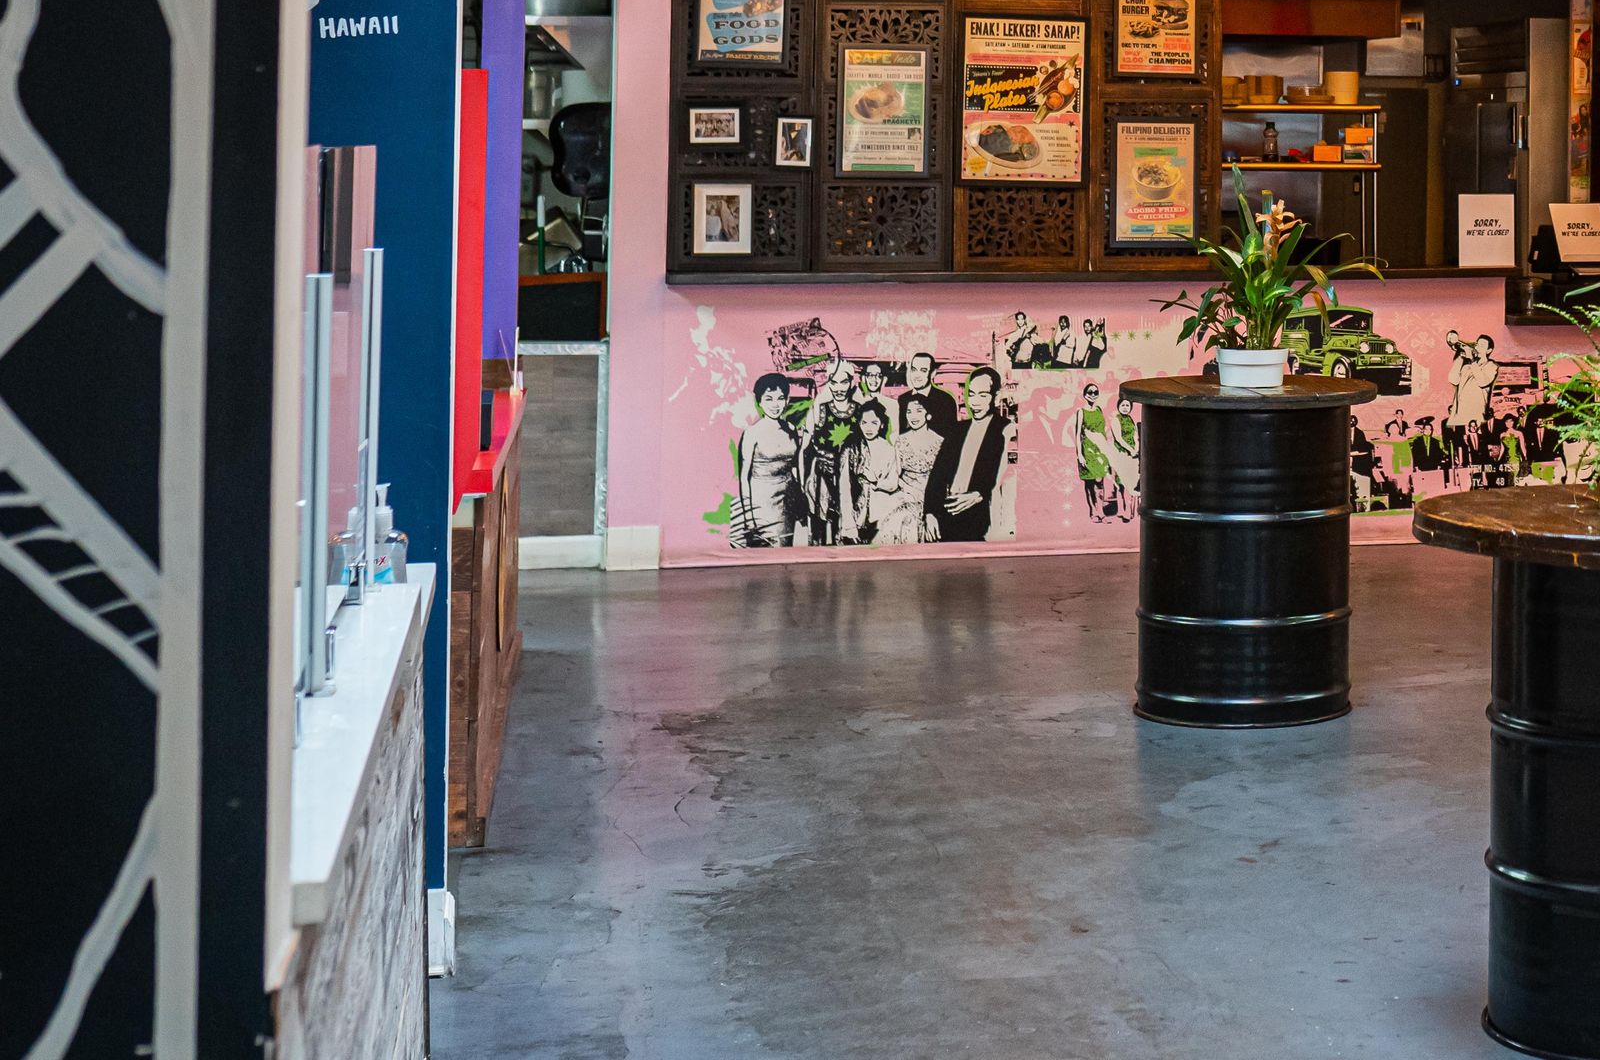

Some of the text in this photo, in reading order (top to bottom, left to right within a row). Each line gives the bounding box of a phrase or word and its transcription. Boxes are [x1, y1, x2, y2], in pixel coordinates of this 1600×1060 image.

[1121, 6, 1149, 15] BURGER
[319, 15, 399, 39] HAWAII
[714, 19, 780, 29] FOOD
[970, 21, 1081, 40] ENAK! LEKKER! SARAP!
[713, 35, 779, 45] GODS
[1148, 57, 1192, 65] CHAMPION
[966, 73, 1040, 97] Indonesian
[983, 91, 1027, 115] Plates
[1121, 125, 1191, 135] FILIPINO DELIGHTS
[1473, 218, 1502, 228] SORRY,
[1567, 222, 1594, 231] SORRY,
[1466, 228, 1510, 237] WE'RE CLOSED
